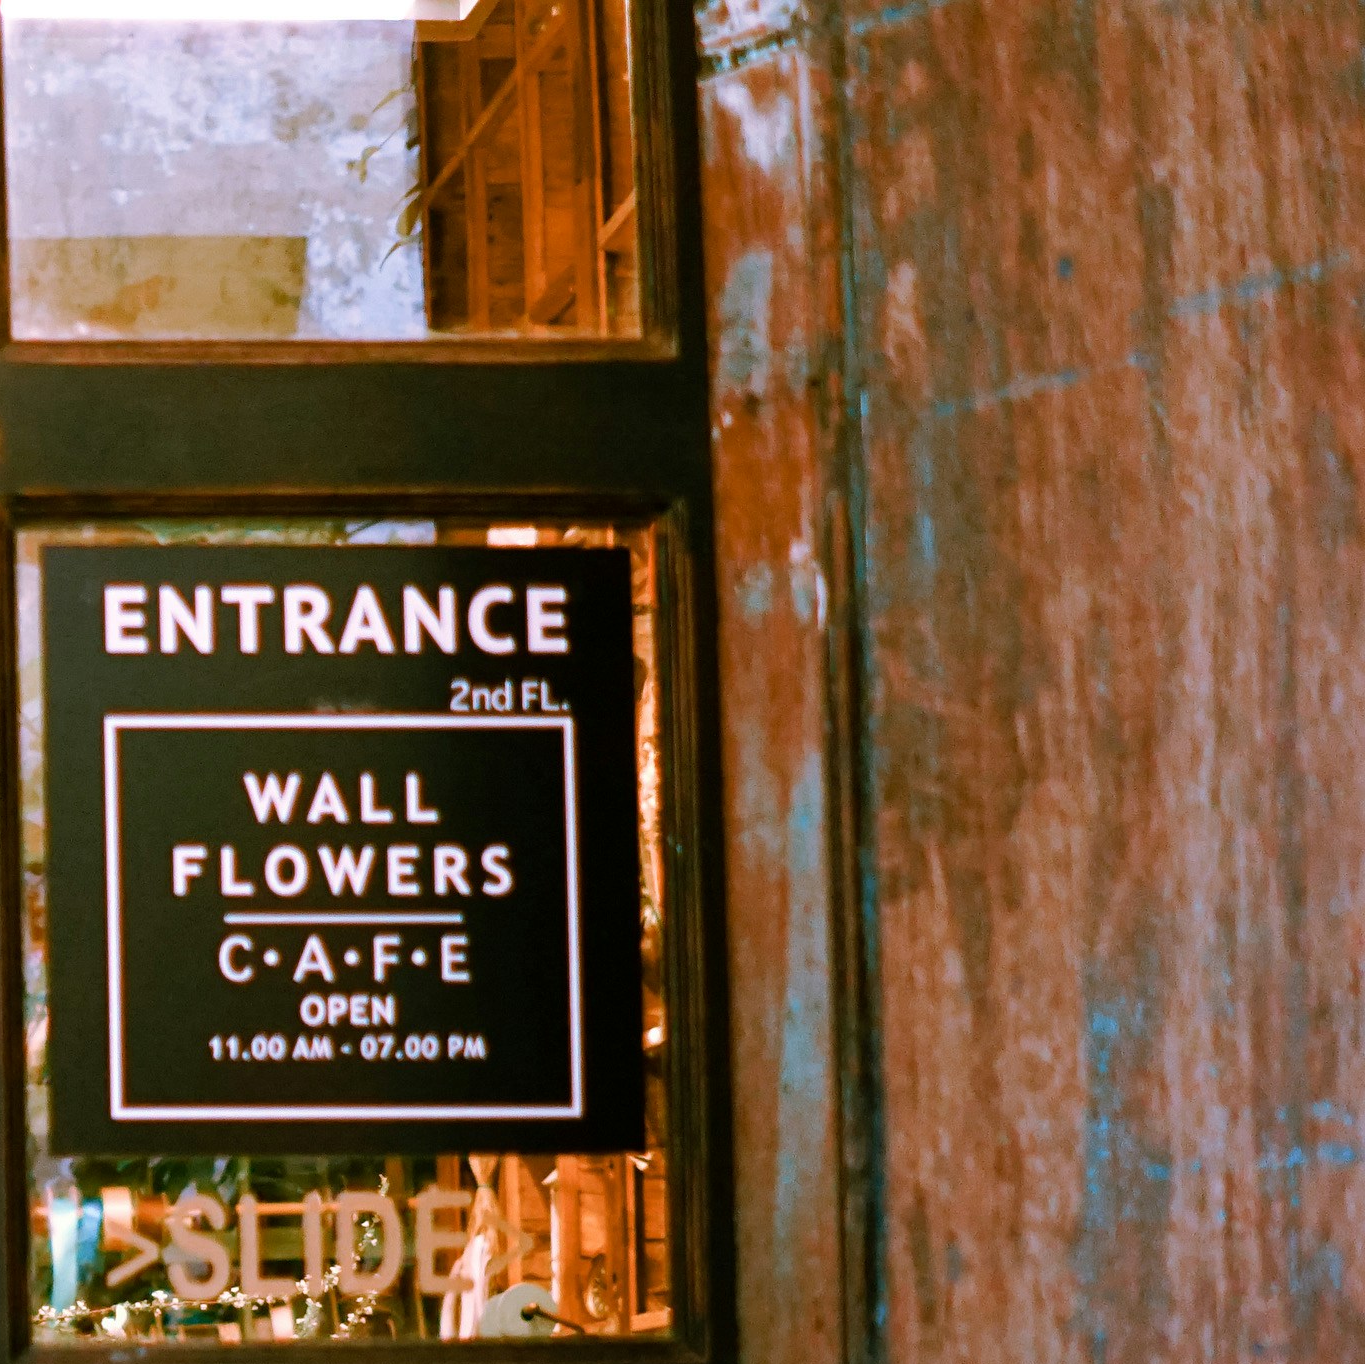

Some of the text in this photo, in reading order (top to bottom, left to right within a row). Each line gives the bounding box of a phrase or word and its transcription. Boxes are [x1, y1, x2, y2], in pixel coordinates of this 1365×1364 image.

[104, 584, 569, 656] ENTRANCE
[449, 678, 570, 712] 2nd FL.
[243, 772, 440, 824] WALL
[172, 845, 513, 898] FLOWERS
[299, 995, 396, 1028] OPEN
[208, 1034, 287, 1061] 11.00
[292, 1036, 332, 1060] AM
[359, 1034, 440, 1060] 07.00
[447, 1035, 487, 1060] PM
